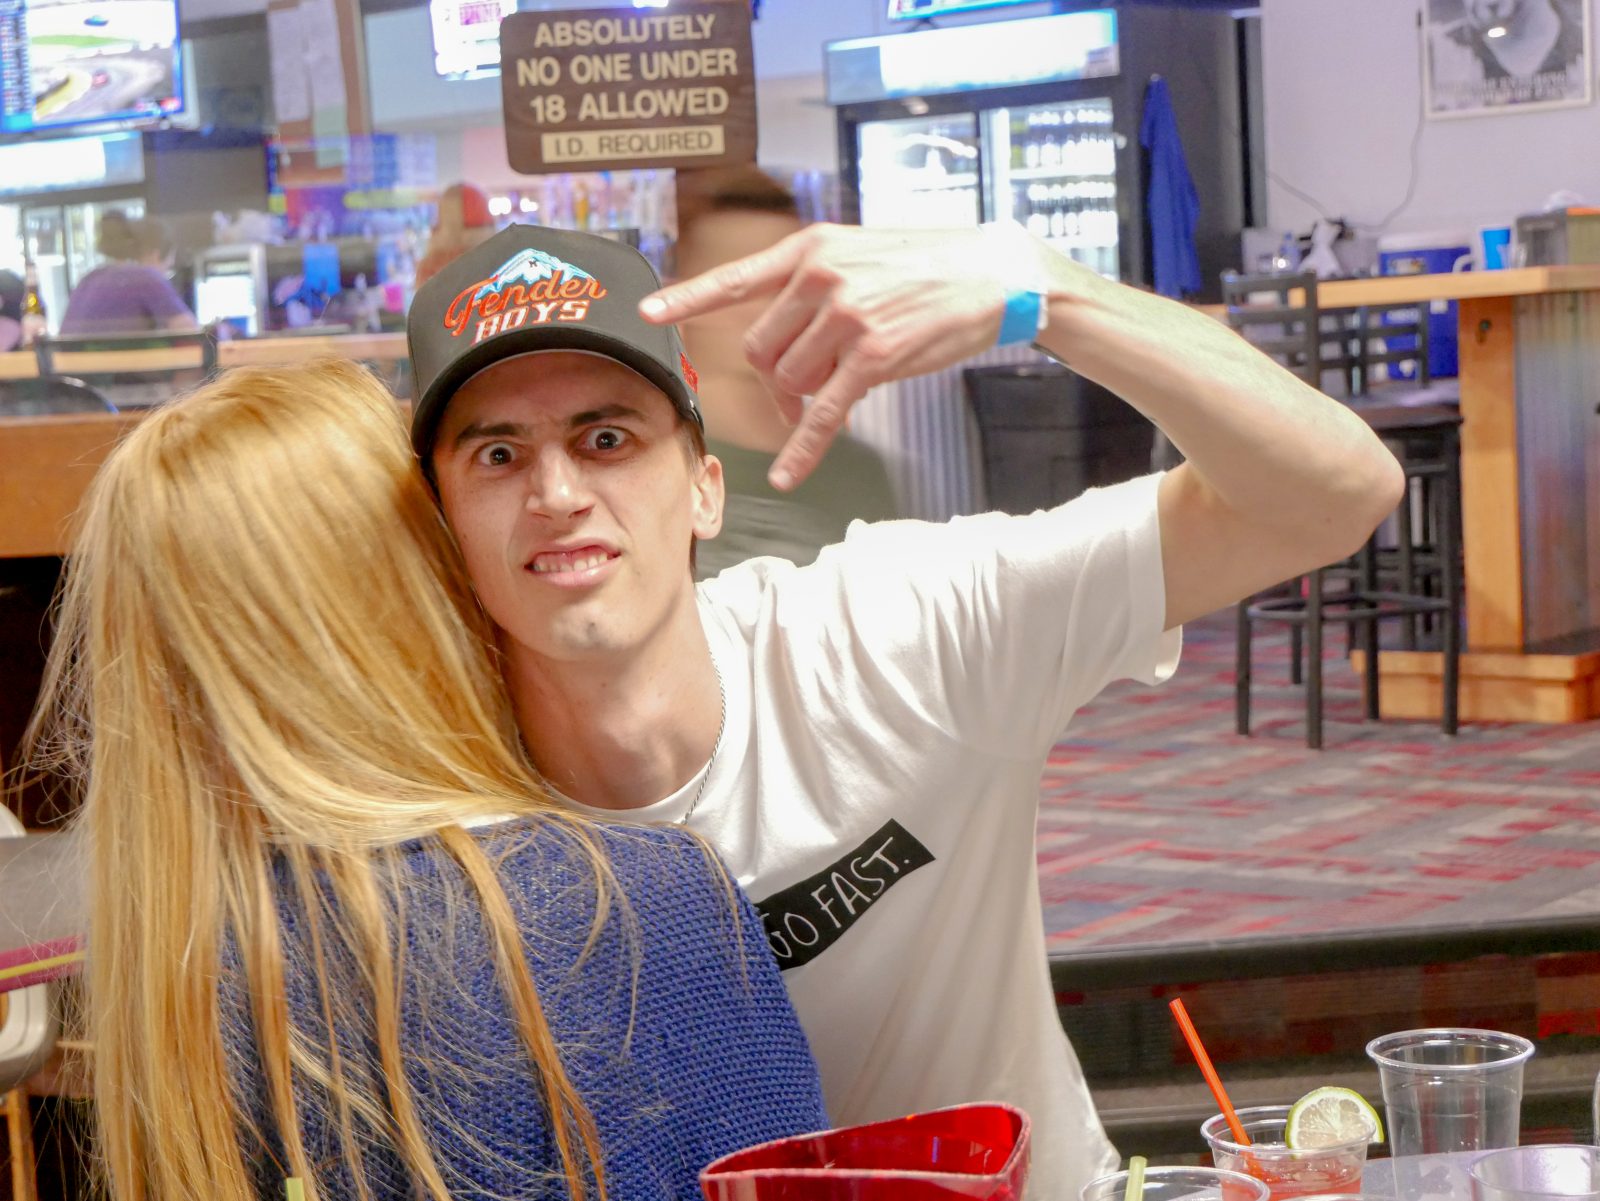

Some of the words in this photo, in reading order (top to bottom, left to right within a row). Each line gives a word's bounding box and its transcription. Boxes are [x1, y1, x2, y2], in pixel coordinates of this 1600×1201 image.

[534, 14, 716, 48] ABSOLUTELY
[516, 56, 561, 87] NO
[569, 53, 632, 85] ONE
[640, 48, 738, 81] UNDER
[530, 94, 567, 124] 18
[578, 87, 729, 122] ALLOWED
[555, 137, 590, 157] I.D.
[599, 130, 714, 154] REQUIRED
[470, 299, 591, 346] BOYS
[810, 836, 910, 929] FAST.
